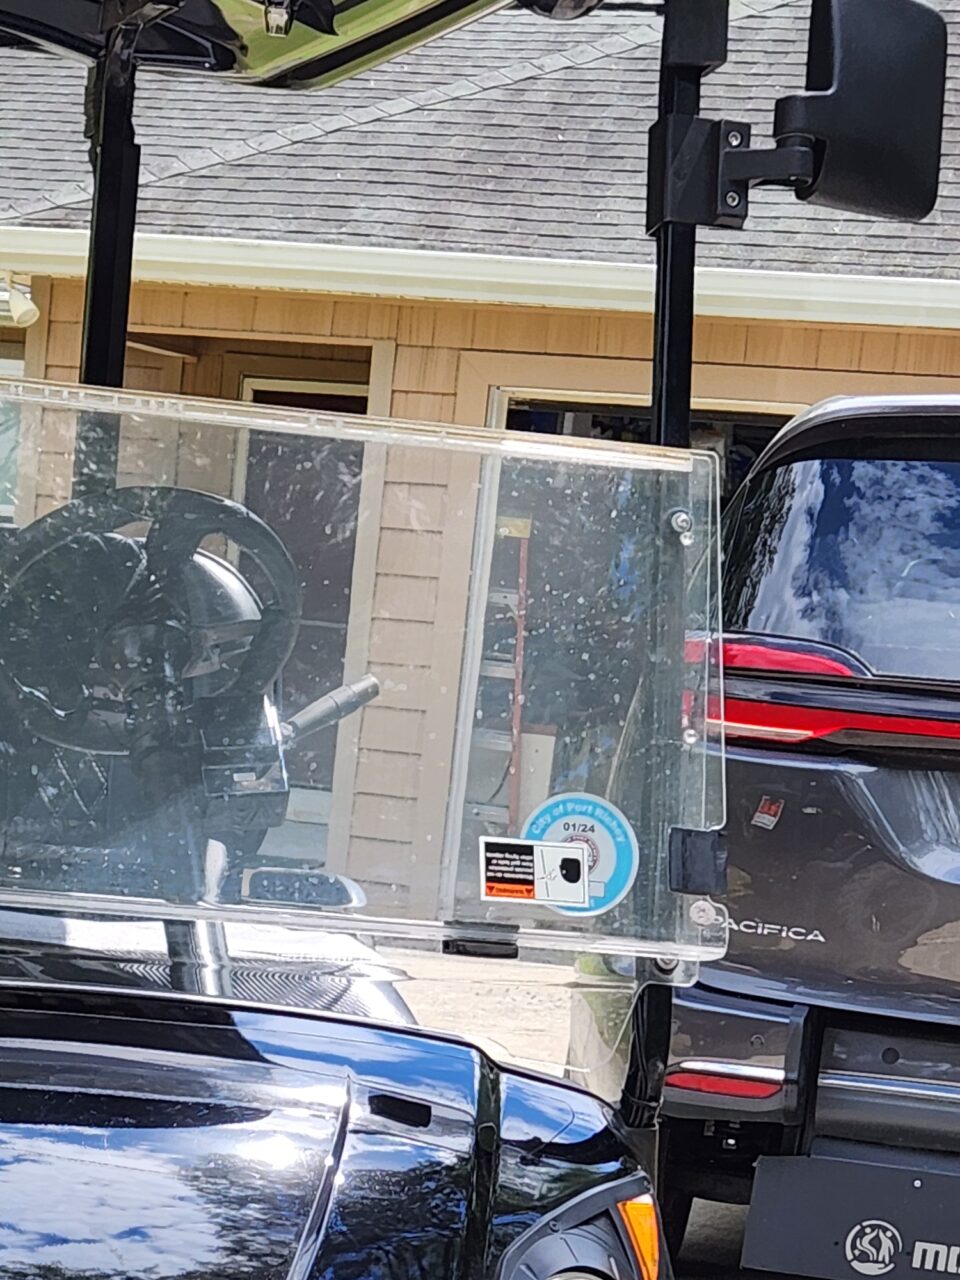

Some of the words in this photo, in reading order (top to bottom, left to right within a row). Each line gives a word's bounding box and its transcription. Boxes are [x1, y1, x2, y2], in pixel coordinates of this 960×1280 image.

[530, 811, 552, 834] City
[552, 804, 565, 817] of
[565, 801, 594, 814] Port
[563, 821, 595, 833] 01/24
